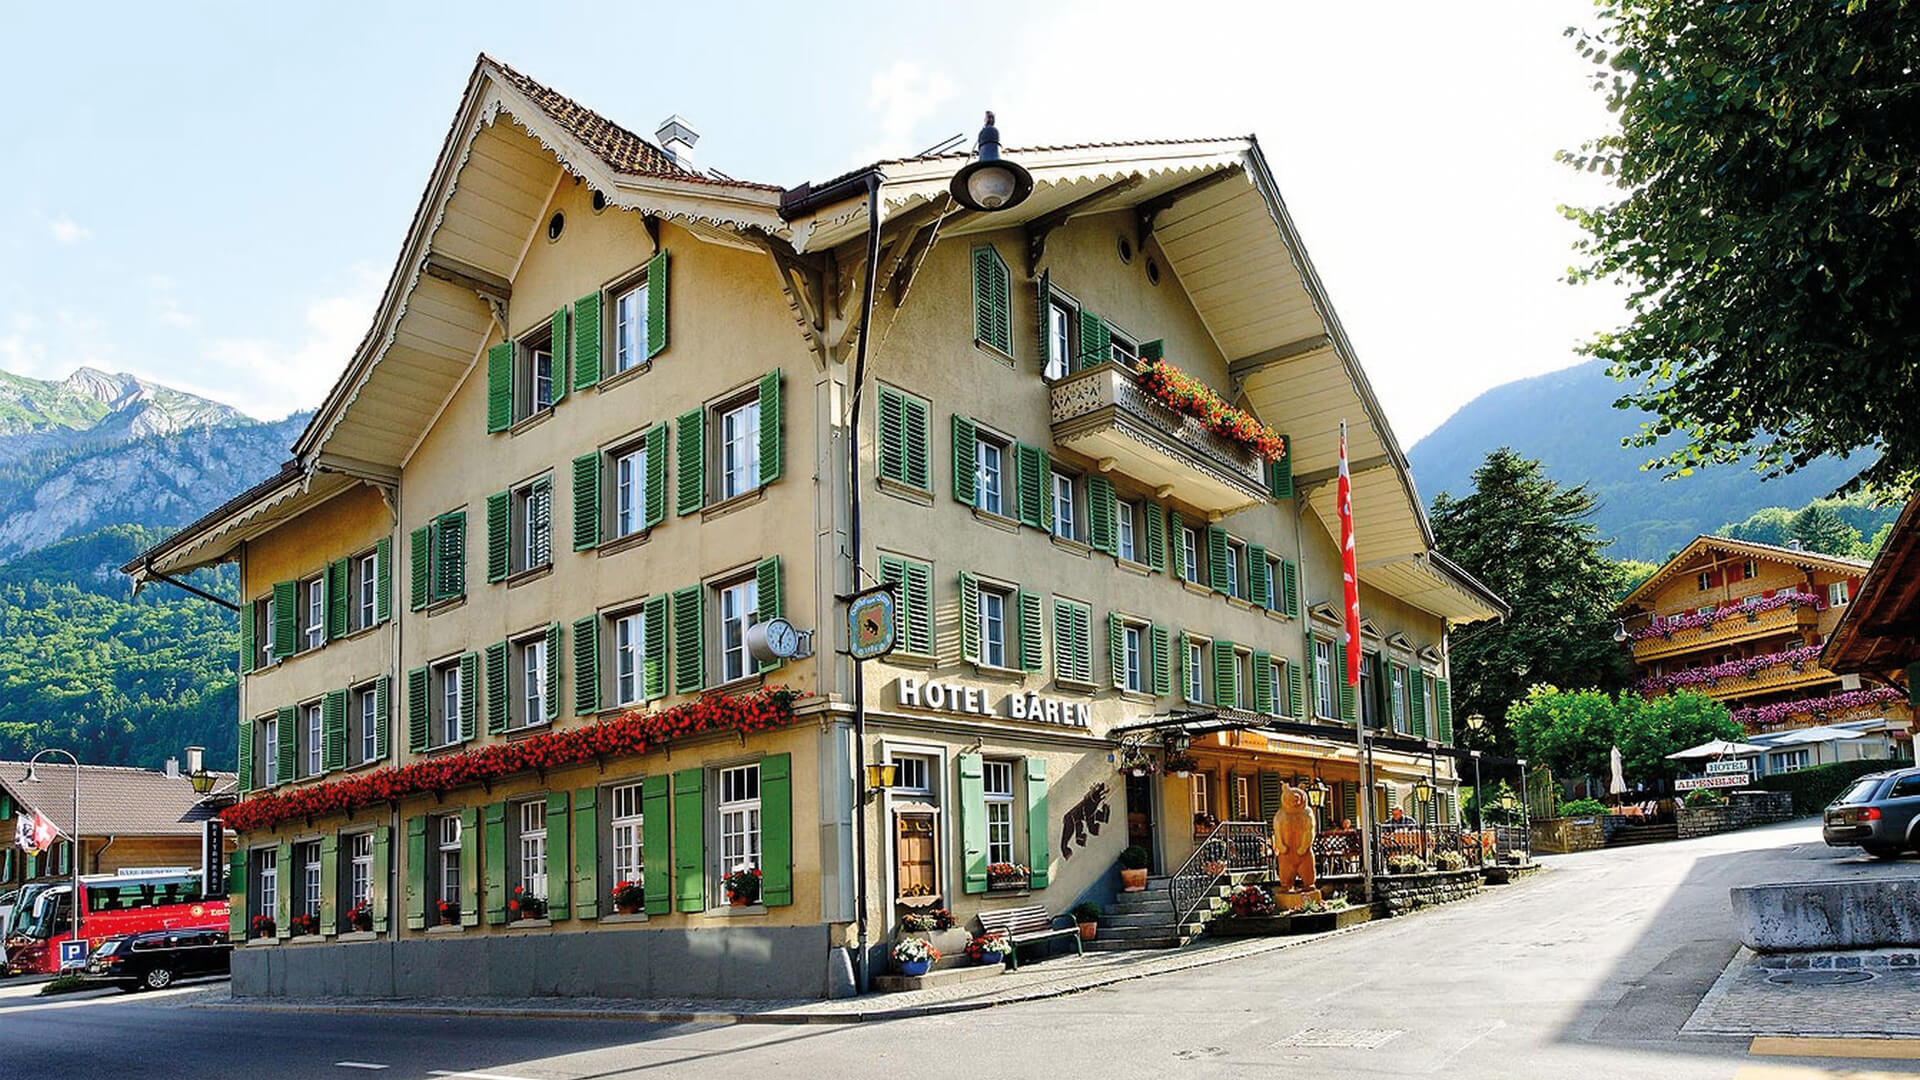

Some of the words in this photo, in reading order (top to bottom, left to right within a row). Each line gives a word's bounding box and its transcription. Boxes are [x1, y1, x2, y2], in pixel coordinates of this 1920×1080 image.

[898, 675, 997, 716] HOTEL
[1010, 690, 1092, 727] BÄREN
[1708, 761, 1747, 772] HOTEL
[1677, 775, 1747, 789] ALPENBLICK
[68, 945, 80, 960] P
